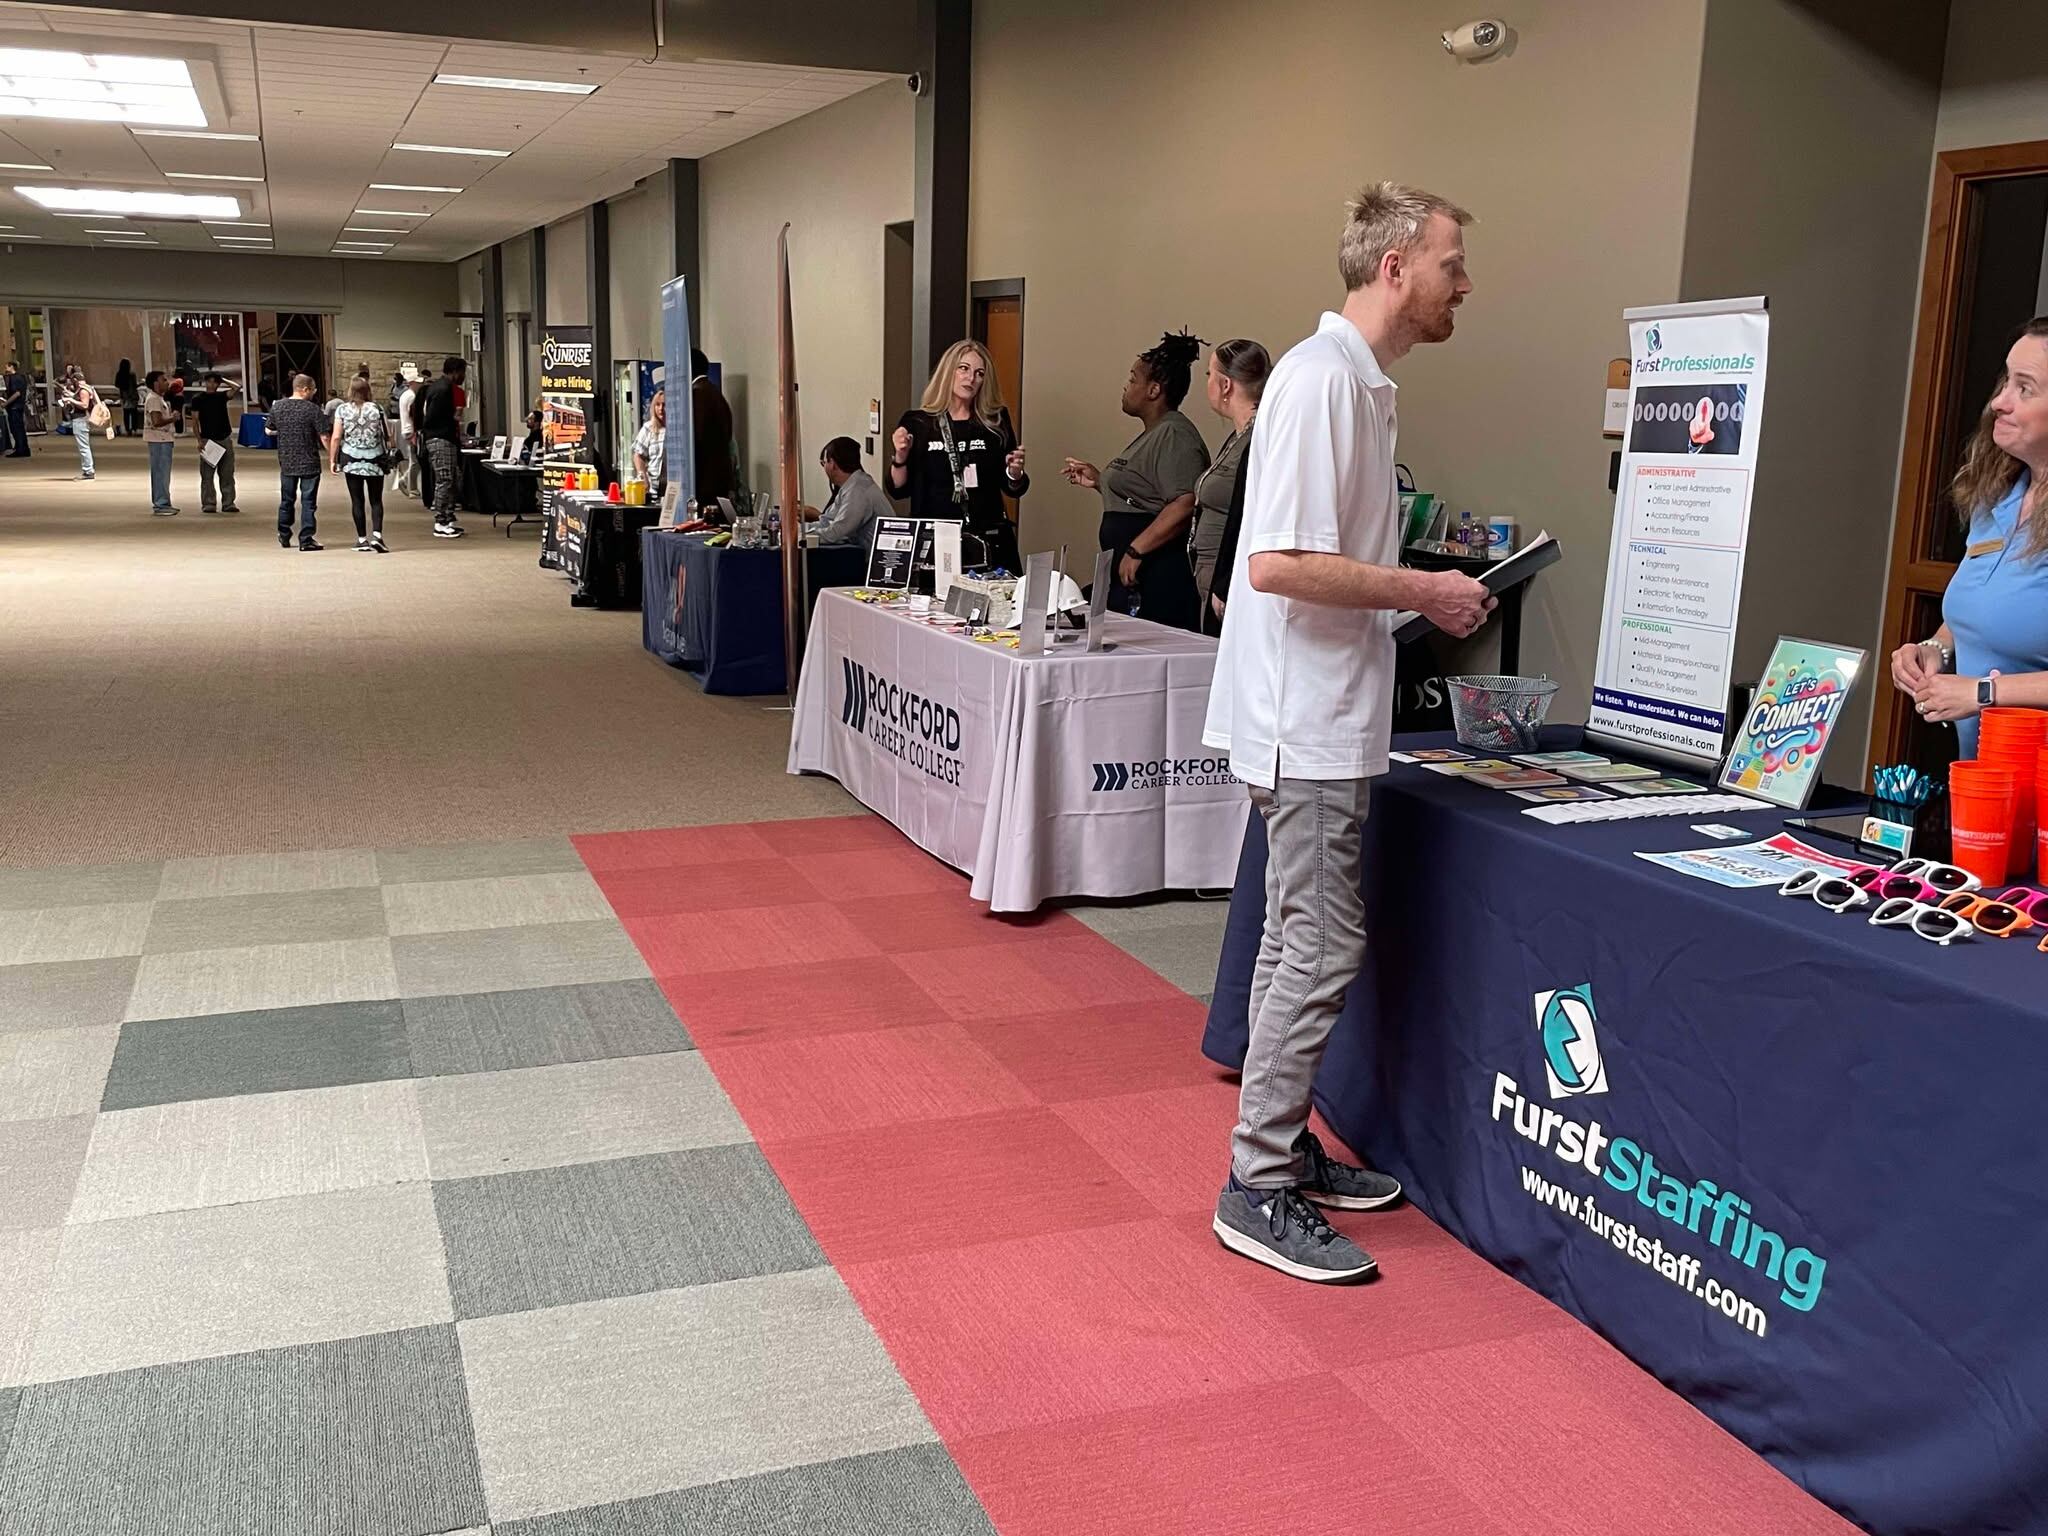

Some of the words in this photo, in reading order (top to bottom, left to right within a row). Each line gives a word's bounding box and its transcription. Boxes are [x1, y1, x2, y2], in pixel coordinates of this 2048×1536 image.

[545, 344, 592, 370] SUNRISE
[542, 376, 553, 388] We
[553, 378, 567, 388] are
[568, 376, 592, 391] Hiring
[1637, 468, 1697, 478] ADMINISTRATIVE
[1654, 483, 1671, 491] Senior
[1673, 483, 1688, 492] Level
[1689, 484, 1732, 494] Administrative
[1652, 497, 1670, 505] Office
[1671, 499, 1711, 508] Management
[1651, 512, 1709, 522] Accounting/Finance
[1650, 526, 1670, 534] Human
[1672, 527, 1700, 536] Resources
[1630, 545, 1667, 555] TECHNICAL
[1646, 560, 1680, 572] Engineering
[1645, 575, 1670, 583] Machine
[1671, 577, 1709, 588] Maintenance
[1643, 588, 1671, 598] Electronic
[1672, 591, 1705, 603] Technicians
[1642, 602, 1675, 612] Information
[1675, 605, 1708, 619] Technology
[1623, 621, 1672, 634] PROFESSIONAL
[1639, 636, 1690, 651] Mid-Management
[1637, 650, 1663, 661] Materials
[1636, 663, 1656, 675] Quality
[1657, 668, 1697, 681] Management
[1634, 677, 1665, 689] Production
[1666, 683, 1698, 696] Supervision
[1784, 678, 1817, 697] LET'S
[868, 671, 961, 751] ROCKFORD
[1595, 692, 1604, 702] We
[1605, 694, 1624, 706] listen.
[1627, 699, 1638, 709] We
[1638, 704, 1677, 717] understand.
[1678, 709, 1689, 720] We
[1690, 715, 1702, 723] can
[1703, 717, 1721, 728] help.
[1748, 690, 1841, 737] CONNECT
[869, 715, 906, 760] CAREER
[1593, 716, 1715, 751] www.furstprofessionals.com
[1131, 758, 1230, 777] ROCKFOR
[1131, 774, 1181, 790] CAREER
[1522, 1165, 1767, 1337] www.furststaff.com
